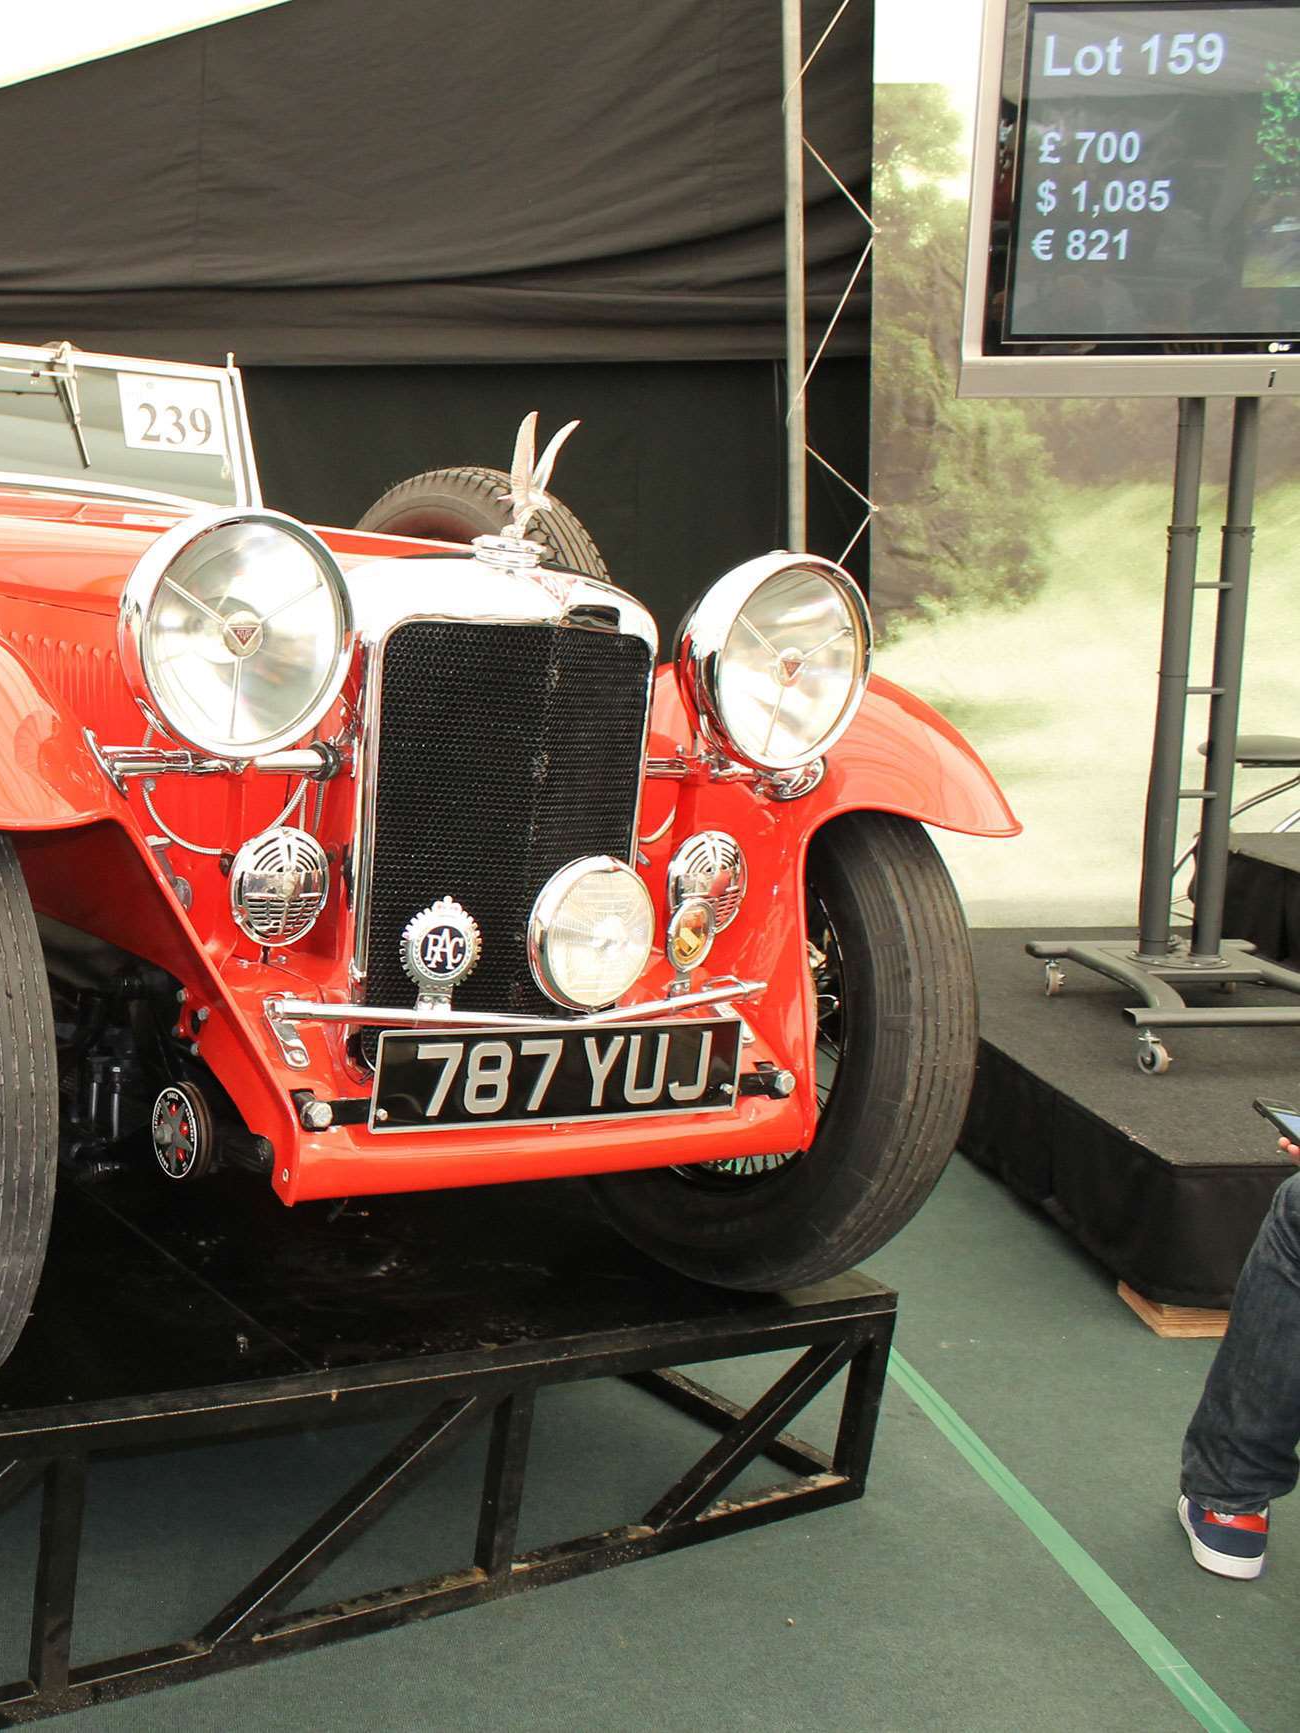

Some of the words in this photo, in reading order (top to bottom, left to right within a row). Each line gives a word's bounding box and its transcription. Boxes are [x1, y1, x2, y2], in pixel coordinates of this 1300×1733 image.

[1043, 36, 1123, 76] Lot
[1140, 33, 1225, 75] 159
[1038, 131, 1061, 164] £
[1075, 131, 1141, 164] 700
[1035, 179, 1057, 216] $
[1071, 180, 1171, 218] 1,085
[1031, 229, 1053, 261] €
[1065, 229, 1130, 261] 821
[139, 403, 211, 446] 239
[424, 928, 464, 970] RAC
[416, 1040, 564, 1117] 787
[584, 1030, 713, 1107] YUJ
